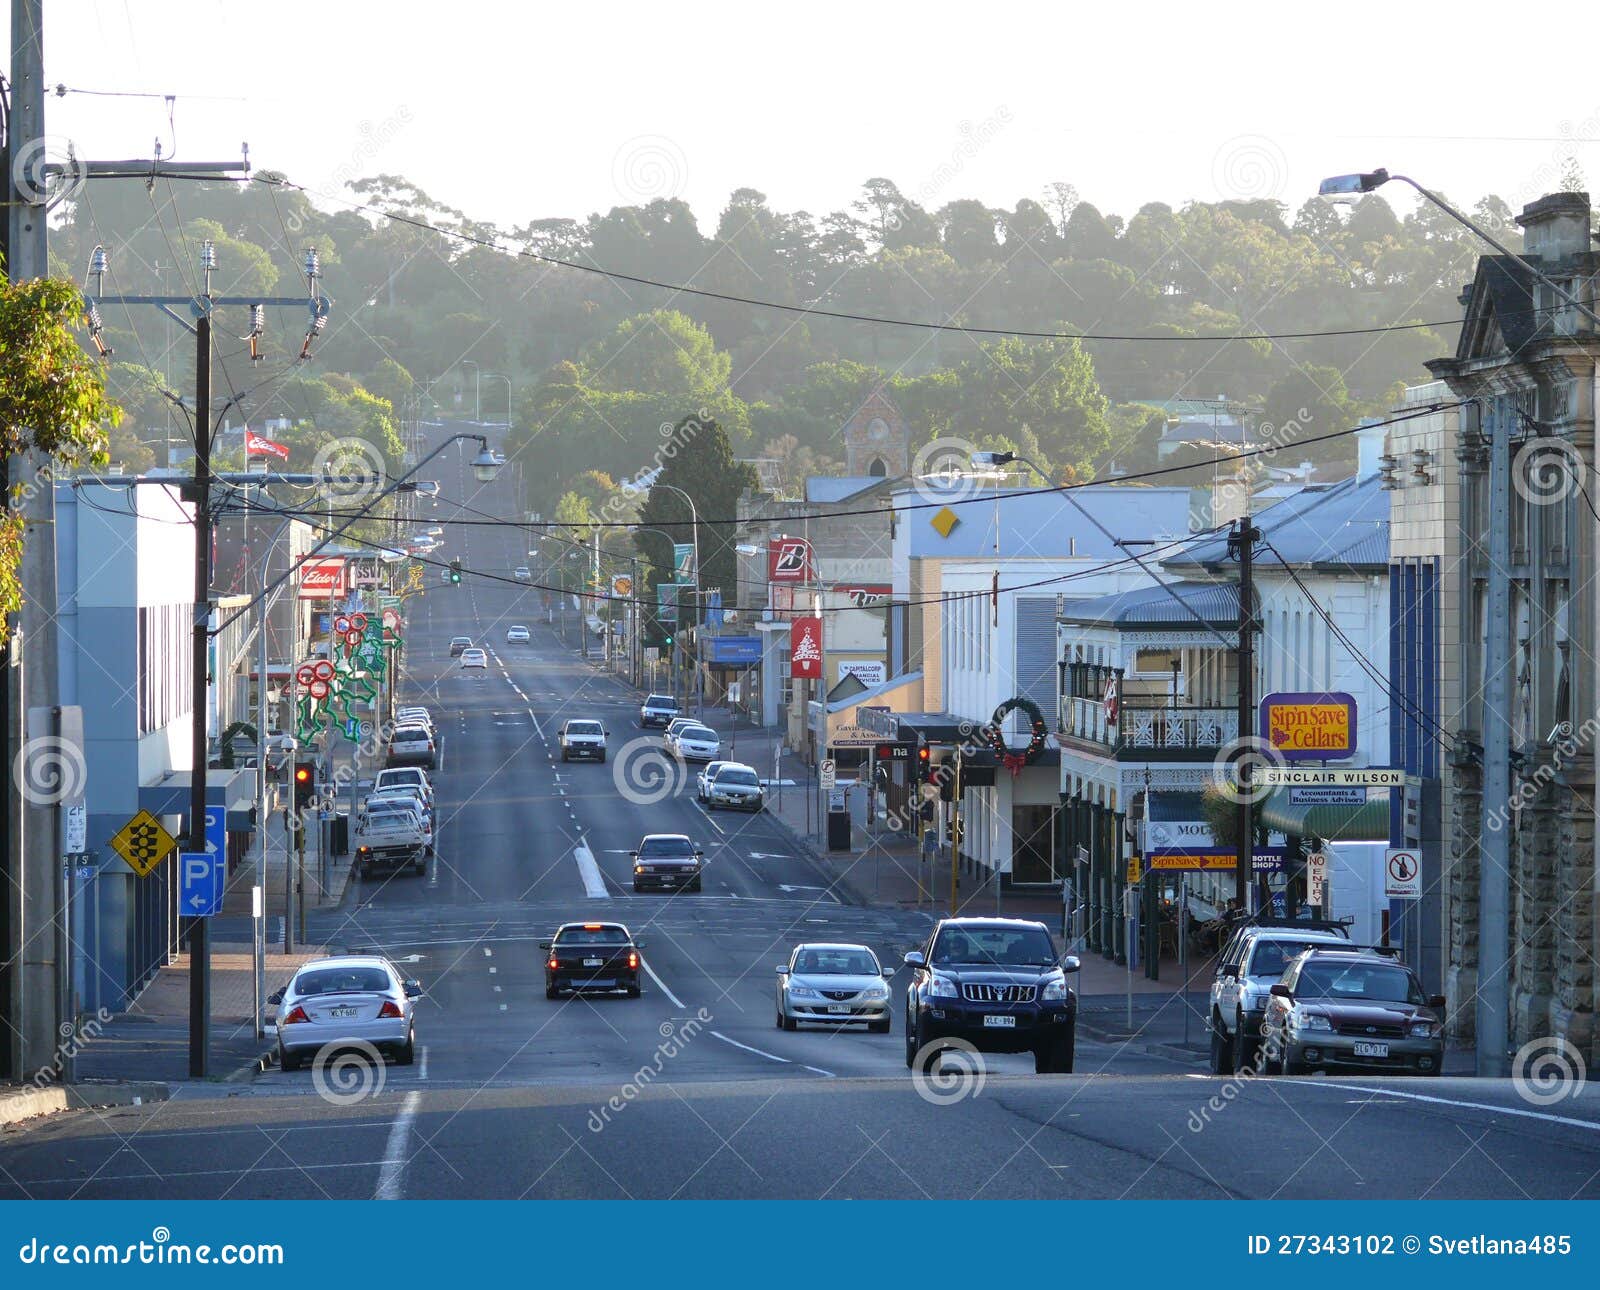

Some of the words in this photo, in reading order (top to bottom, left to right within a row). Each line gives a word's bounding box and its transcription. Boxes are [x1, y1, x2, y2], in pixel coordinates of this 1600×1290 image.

[1271, 706, 1308, 731] Sip'n
[1309, 706, 1346, 726] Save
[1293, 727, 1346, 748] Cellars
[1268, 773, 1336, 783] SINCLAIR
[1344, 773, 1400, 783] WILSON
[1309, 856, 1325, 866] NO
[185, 860, 209, 888] P
[1312, 869, 1323, 902] ENTRY
